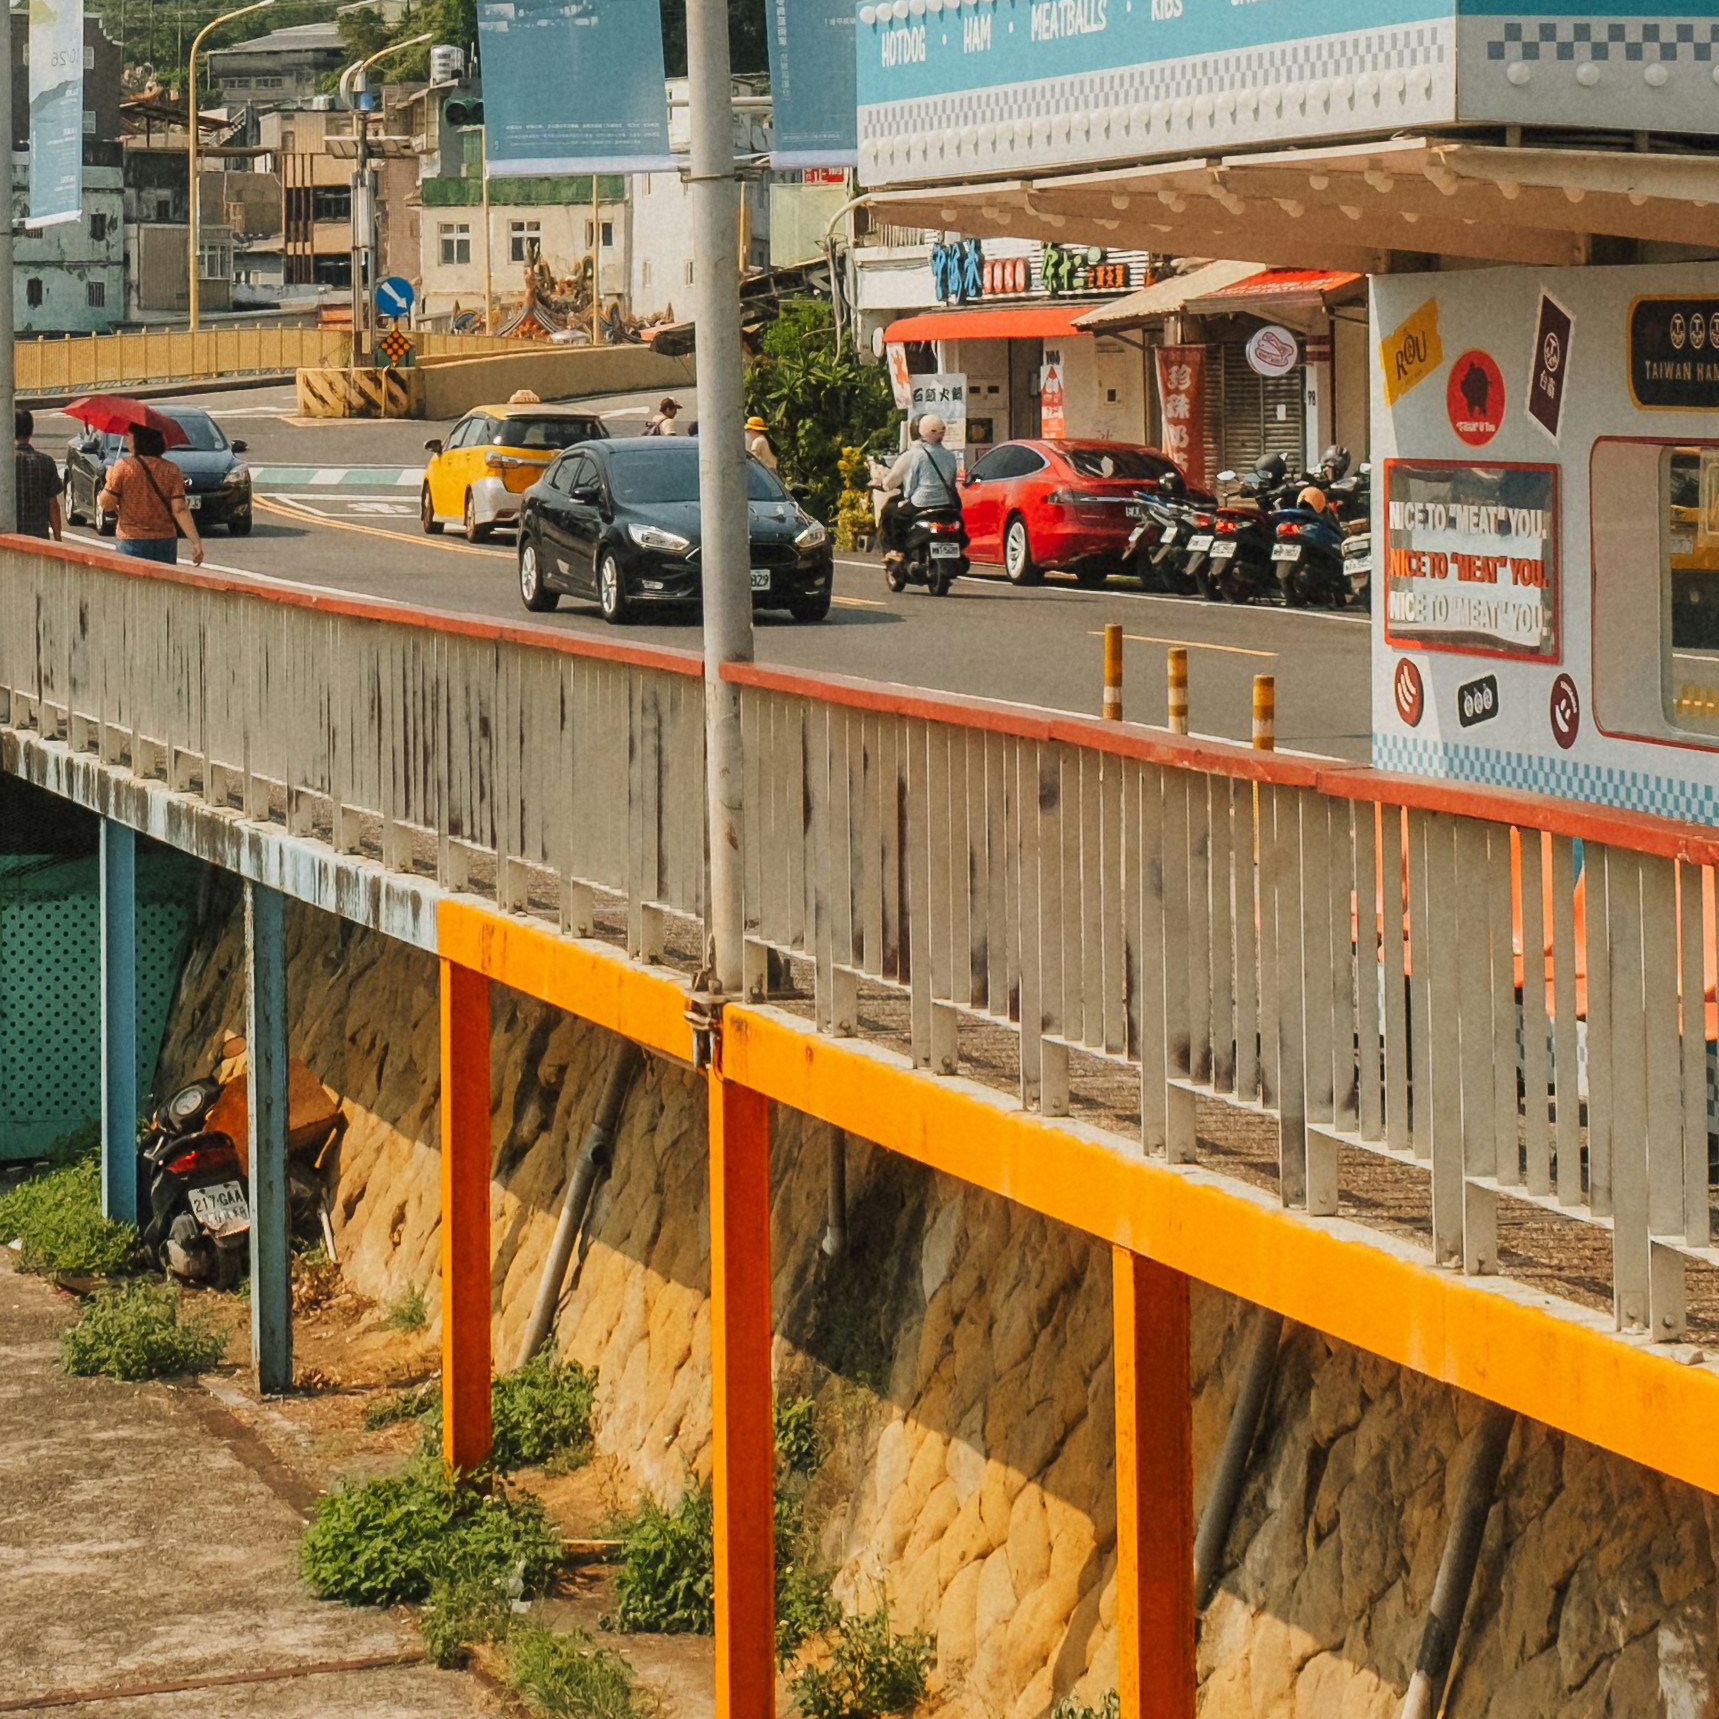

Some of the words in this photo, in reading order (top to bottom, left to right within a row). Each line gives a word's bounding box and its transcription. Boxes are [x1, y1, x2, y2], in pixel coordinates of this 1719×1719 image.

[880, 28, 927, 68] HOTDOG
[963, 15, 992, 54] HAM
[1645, 360, 1692, 381] TAIWAN
[1389, 501, 1426, 530] NICE
[1427, 502, 1447, 531] TO
[1507, 508, 1548, 540] YOU.
[1390, 548, 1427, 578] NICE
[1428, 551, 1448, 580] TO
[1509, 556, 1550, 589] YOU.
[1389, 591, 1427, 622] NICE
[1430, 594, 1449, 623] TO
